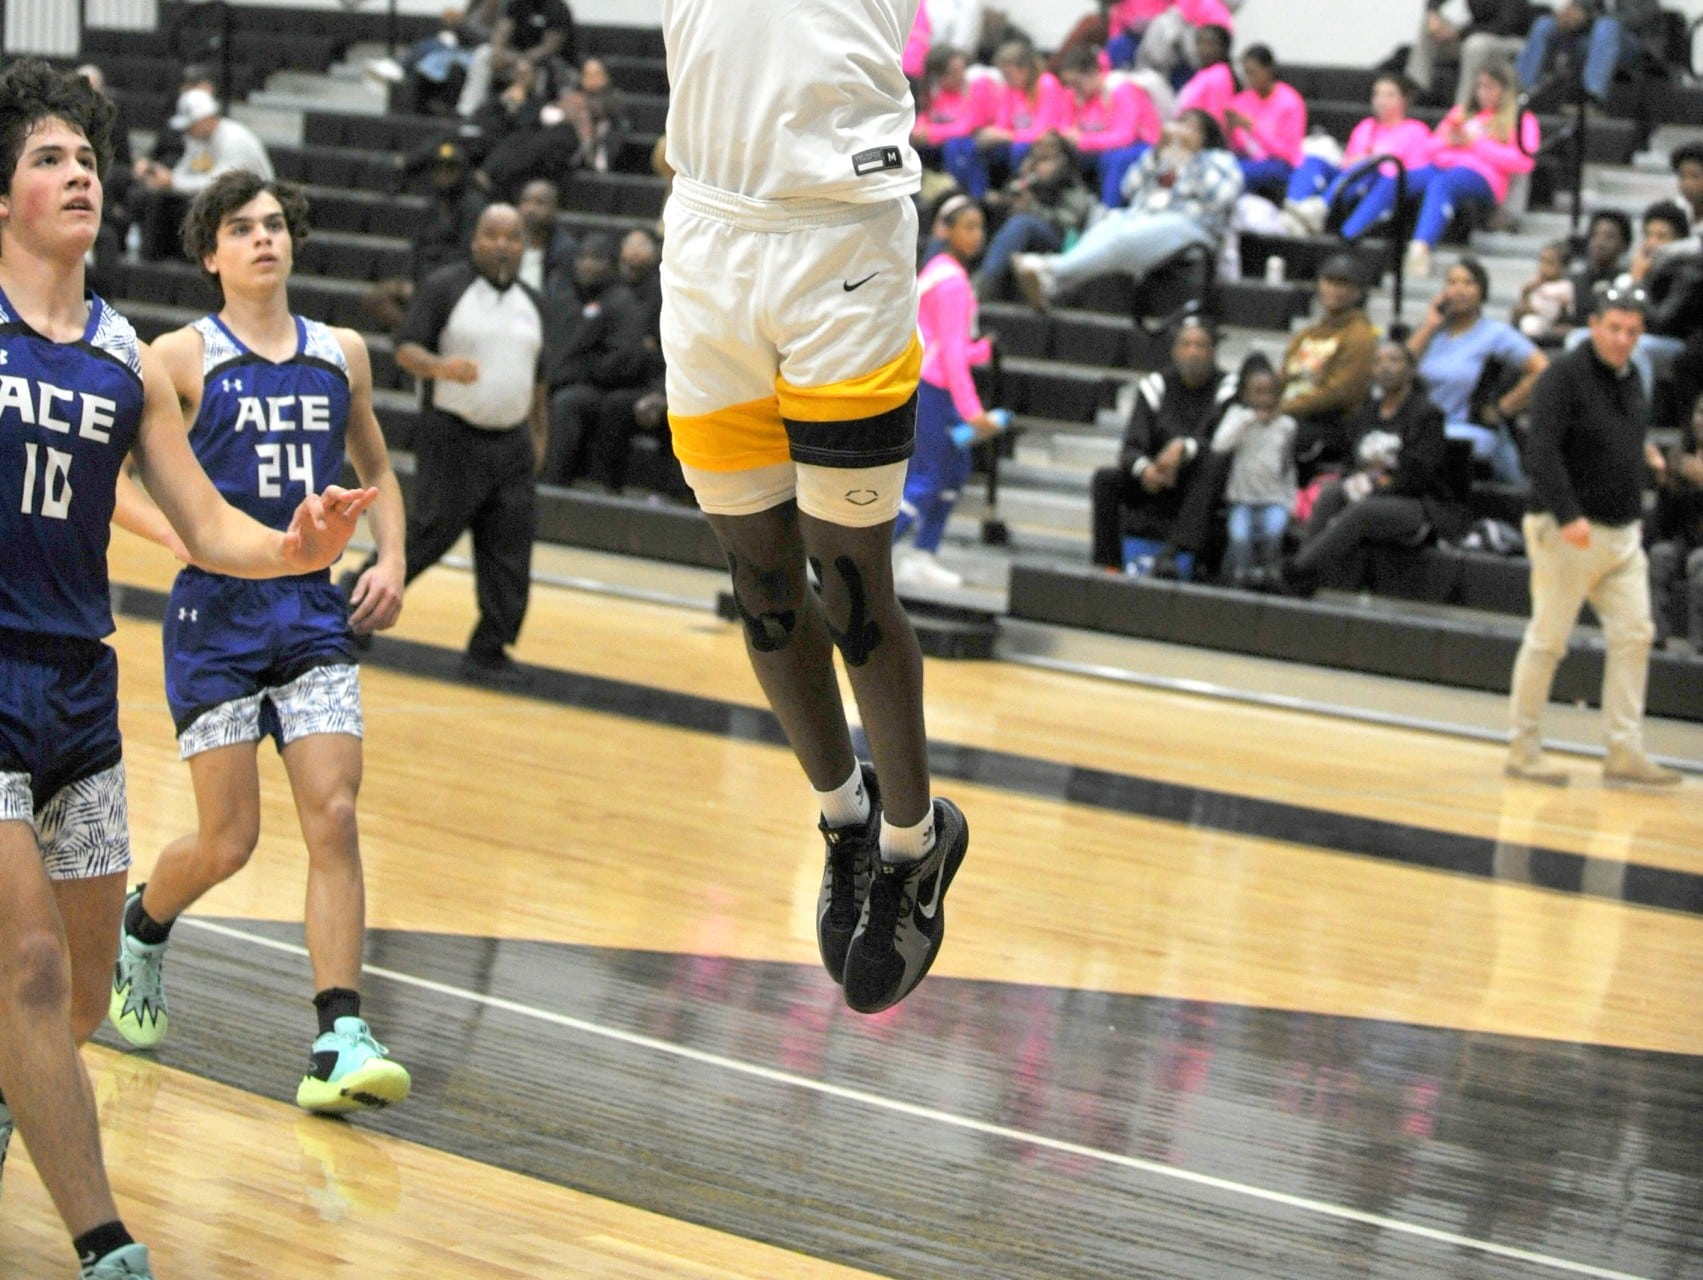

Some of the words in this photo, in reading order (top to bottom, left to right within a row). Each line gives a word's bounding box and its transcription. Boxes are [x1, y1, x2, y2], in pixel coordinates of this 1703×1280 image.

[887, 151, 897, 162] M
[0, 374, 117, 445] ACE
[234, 394, 330, 432] ACE
[20, 441, 73, 520] 10
[254, 443, 315, 498] 24
